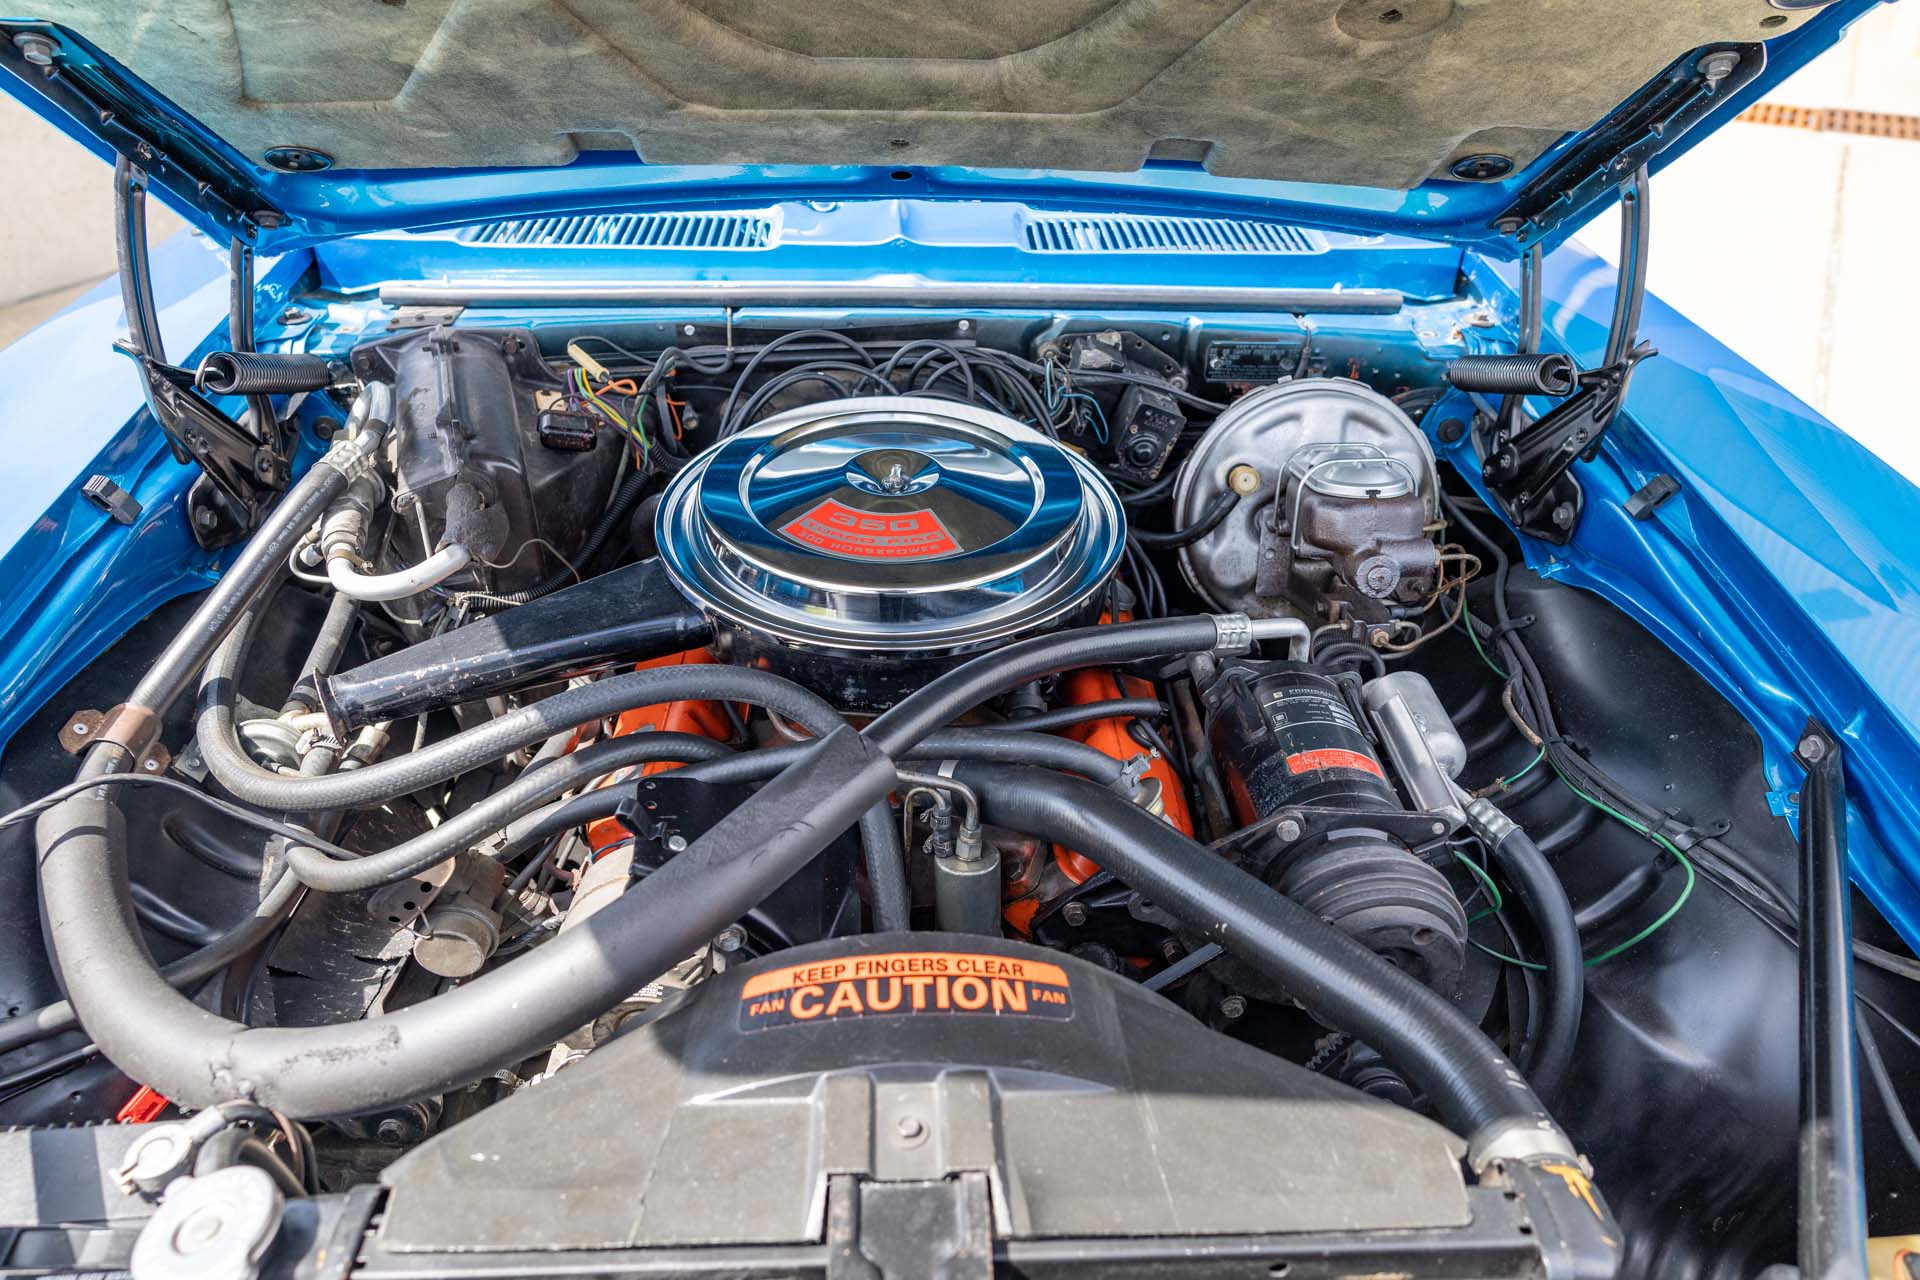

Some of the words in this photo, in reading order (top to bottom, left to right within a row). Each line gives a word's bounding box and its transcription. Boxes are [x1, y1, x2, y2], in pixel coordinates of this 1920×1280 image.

[829, 511, 919, 532] 350
[831, 542, 941, 555] HORSEPOWER
[793, 964, 846, 985] KEEP
[855, 958, 948, 975] FINGERS
[957, 959, 1024, 977] CLEAR
[750, 998, 785, 1016] FAN
[789, 976, 1028, 1019] CAUTION
[1031, 988, 1066, 1005] FAN
